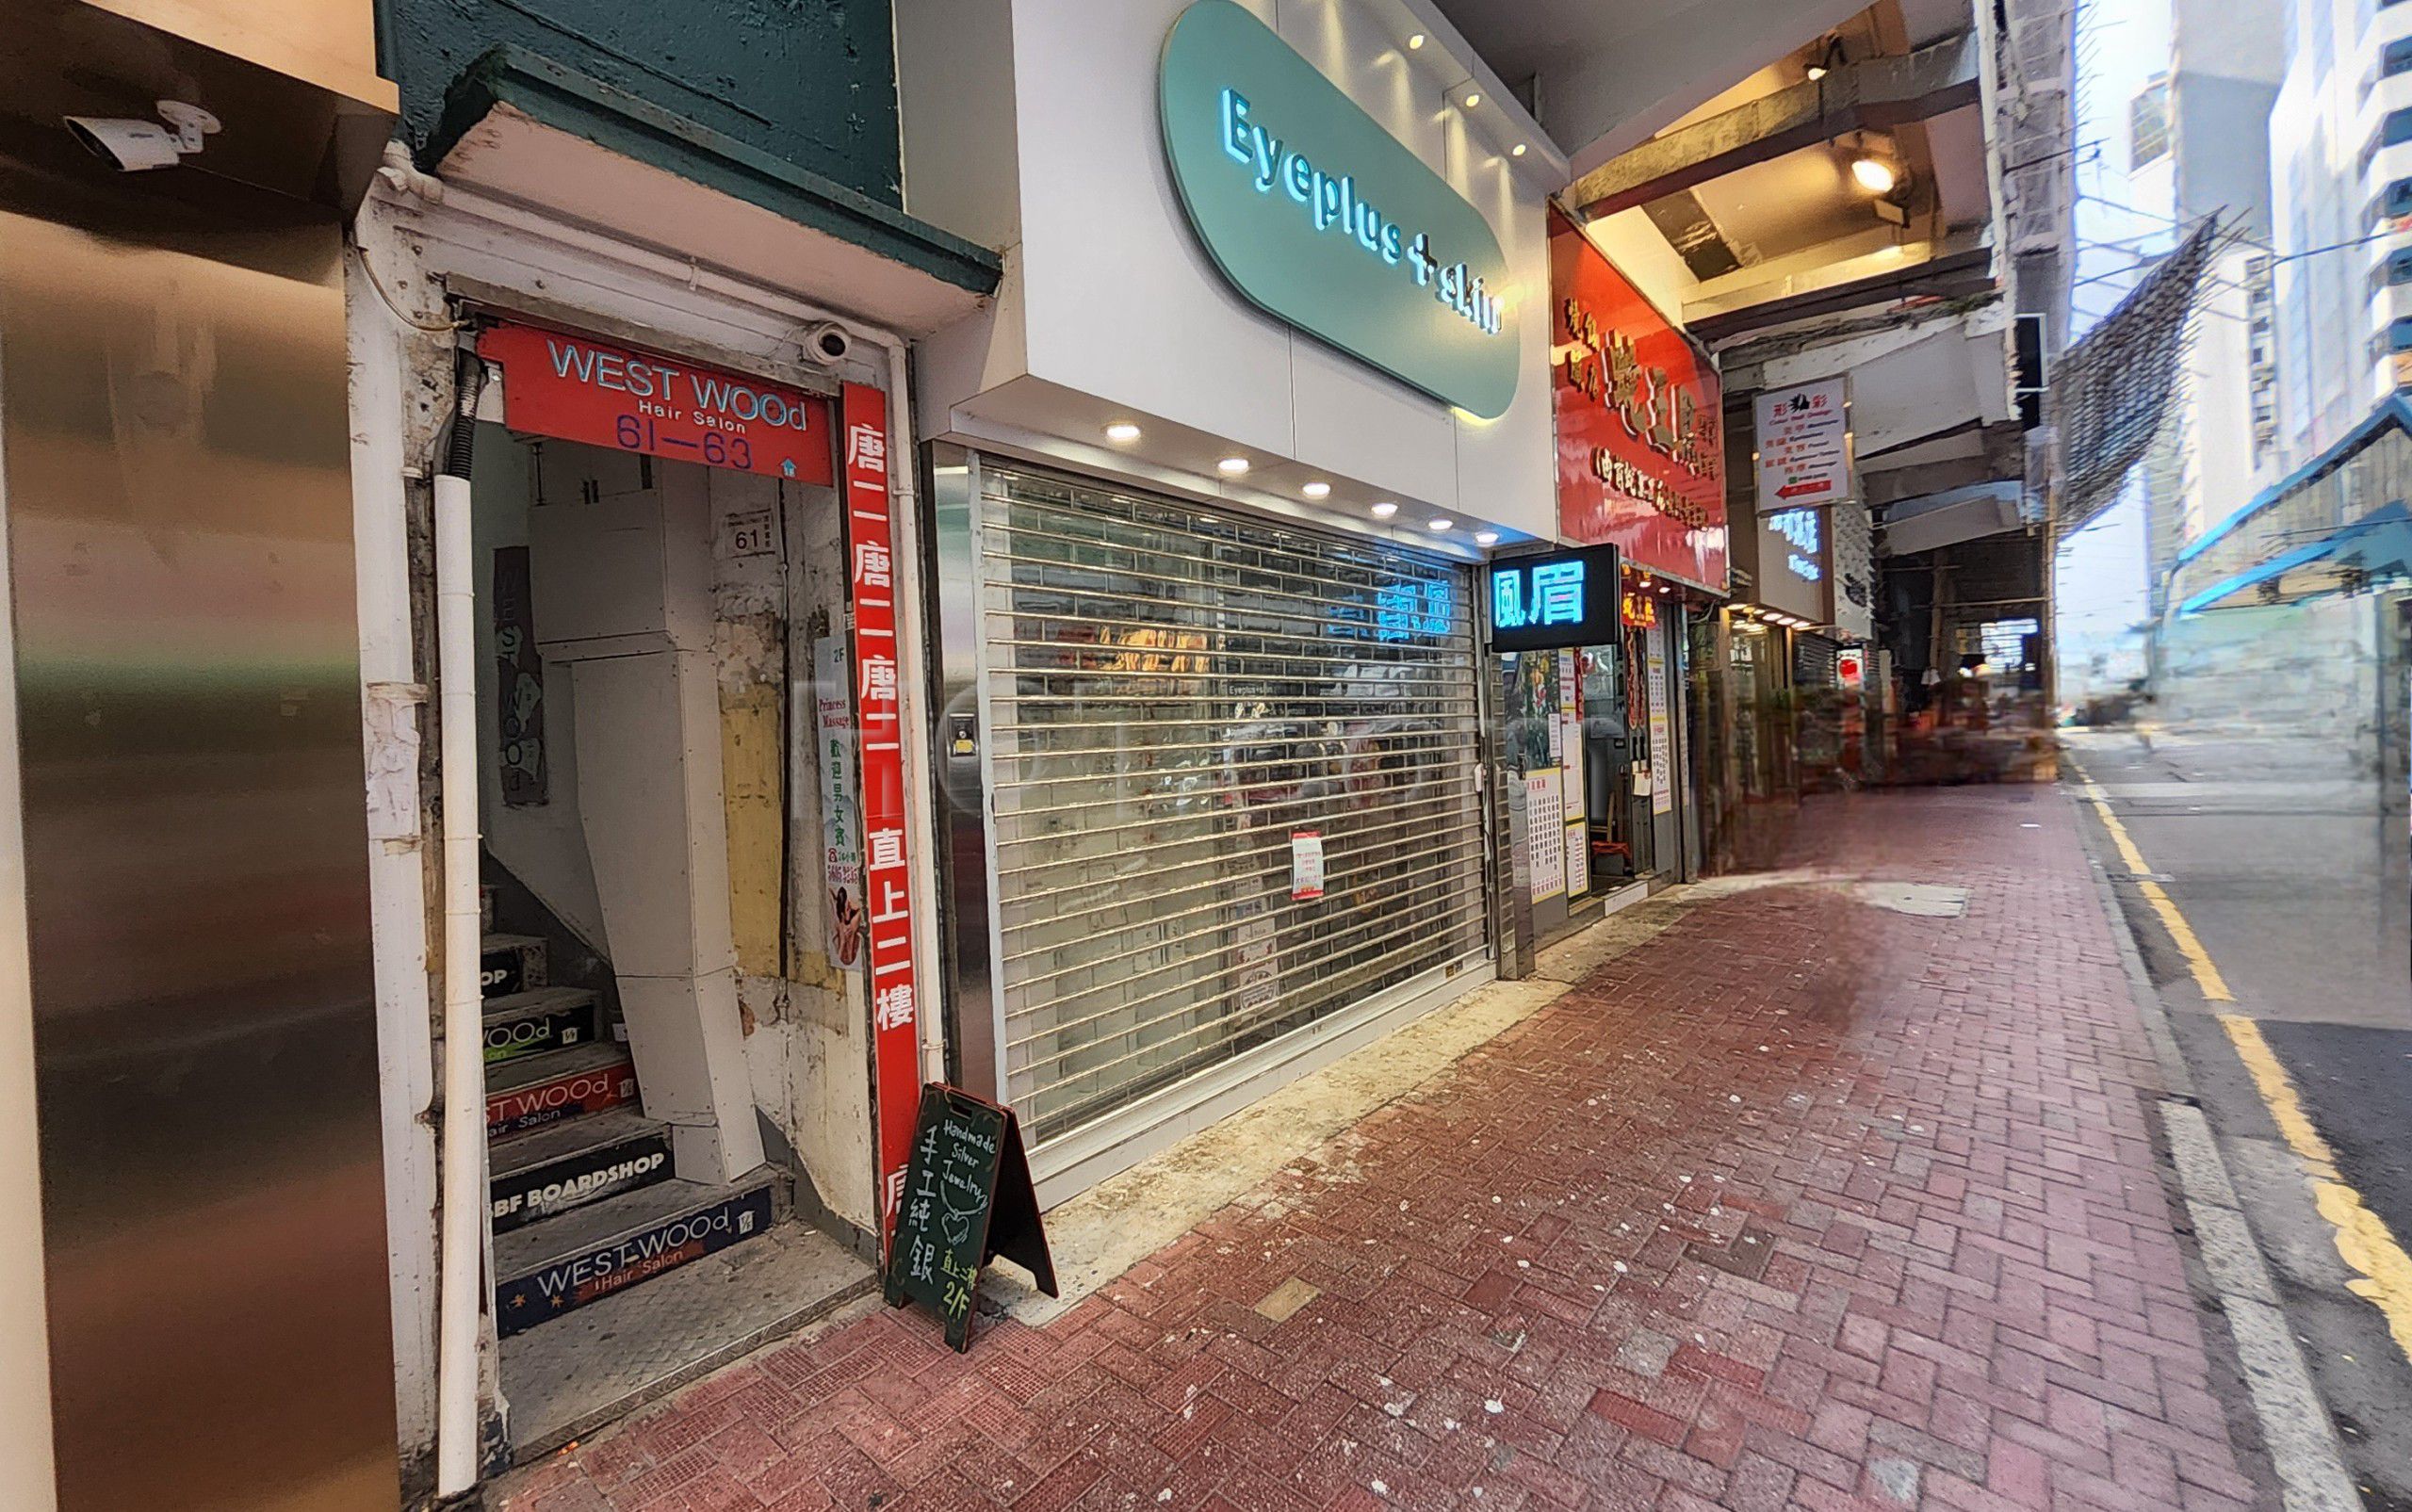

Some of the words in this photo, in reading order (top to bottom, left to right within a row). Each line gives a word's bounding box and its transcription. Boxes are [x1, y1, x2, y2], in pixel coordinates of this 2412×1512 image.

[1222, 88, 1401, 266] Eyeplus
[1438, 262, 1504, 335] skin
[546, 338, 679, 401] WEST
[638, 399, 682, 420] Hair
[693, 411, 746, 434] Salon
[735, 528, 758, 549] 61
[819, 697, 846, 713] Princess
[869, 826, 914, 1032] 直上二樓
[518, 1109, 562, 1130] Salon
[943, 1119, 996, 1154] Handmade
[952, 1142, 980, 1168] Silver
[528, 1152, 664, 1209] BOARDSHOP
[942, 1160, 984, 1203] Jewelry
[908, 1125, 938, 1285] 手工純銀
[538, 1245, 633, 1297] WEST
[602, 1271, 633, 1291] Hair
[643, 1250, 684, 1275] Salon
[943, 1281, 970, 1320] 2/F
